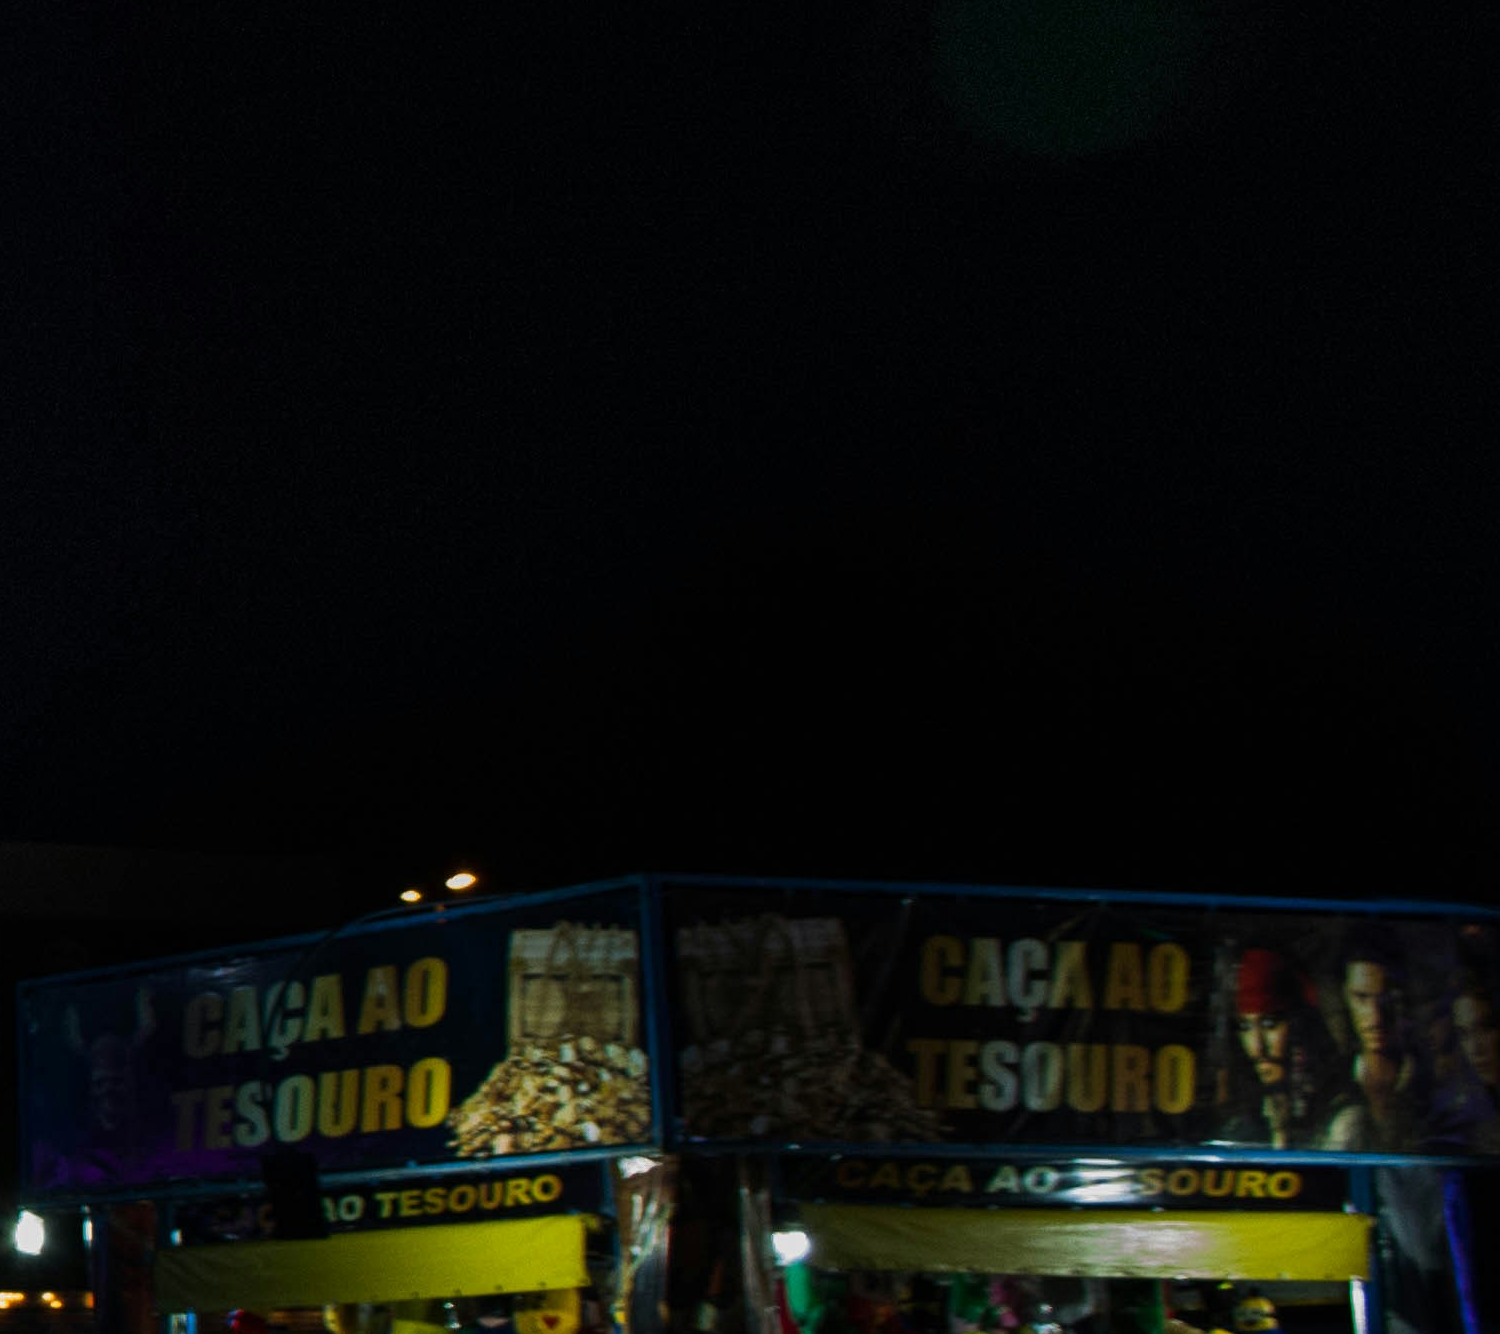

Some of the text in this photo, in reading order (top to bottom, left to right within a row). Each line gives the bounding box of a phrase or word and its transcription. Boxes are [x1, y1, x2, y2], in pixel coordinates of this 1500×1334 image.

[182, 955, 450, 1063] CAÇA AO
[919, 933, 1190, 1024] CAÇA AO
[170, 1055, 453, 1153] TESOURO
[908, 1036, 1198, 1117] TESOURO
[376, 1172, 565, 1221] TESOURO
[833, 1164, 973, 1199] CAÇA
[986, 1166, 1061, 1197] AO
